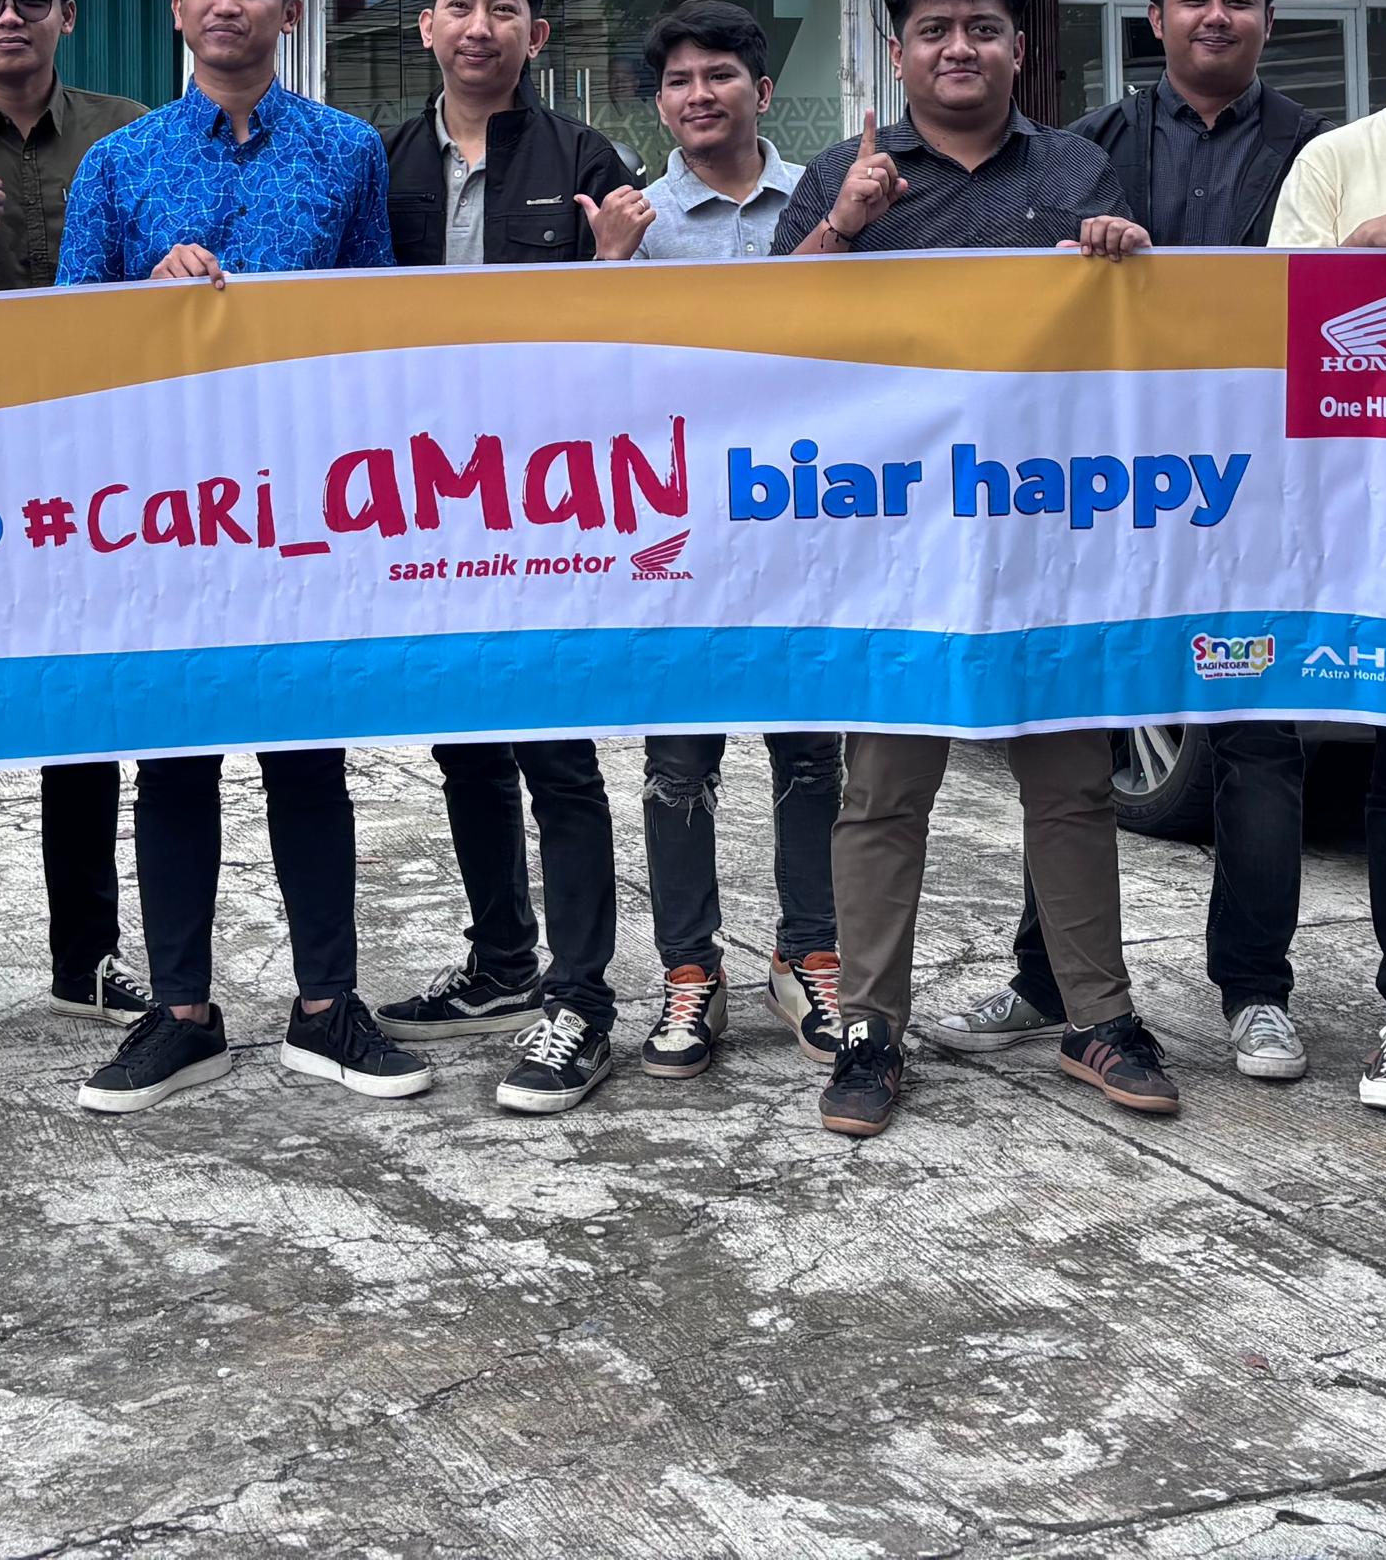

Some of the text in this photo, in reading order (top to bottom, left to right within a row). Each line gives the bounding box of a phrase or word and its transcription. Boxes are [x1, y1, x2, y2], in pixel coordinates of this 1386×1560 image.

[1319, 396, 1361, 419] One
[728, 439, 923, 521] biar
[951, 443, 1252, 530] happy
[388, 552, 616, 582] saat naik motor
[631, 569, 695, 581] HONDA
[1301, 667, 1316, 678] PT
[1319, 668, 1350, 680] Astra
